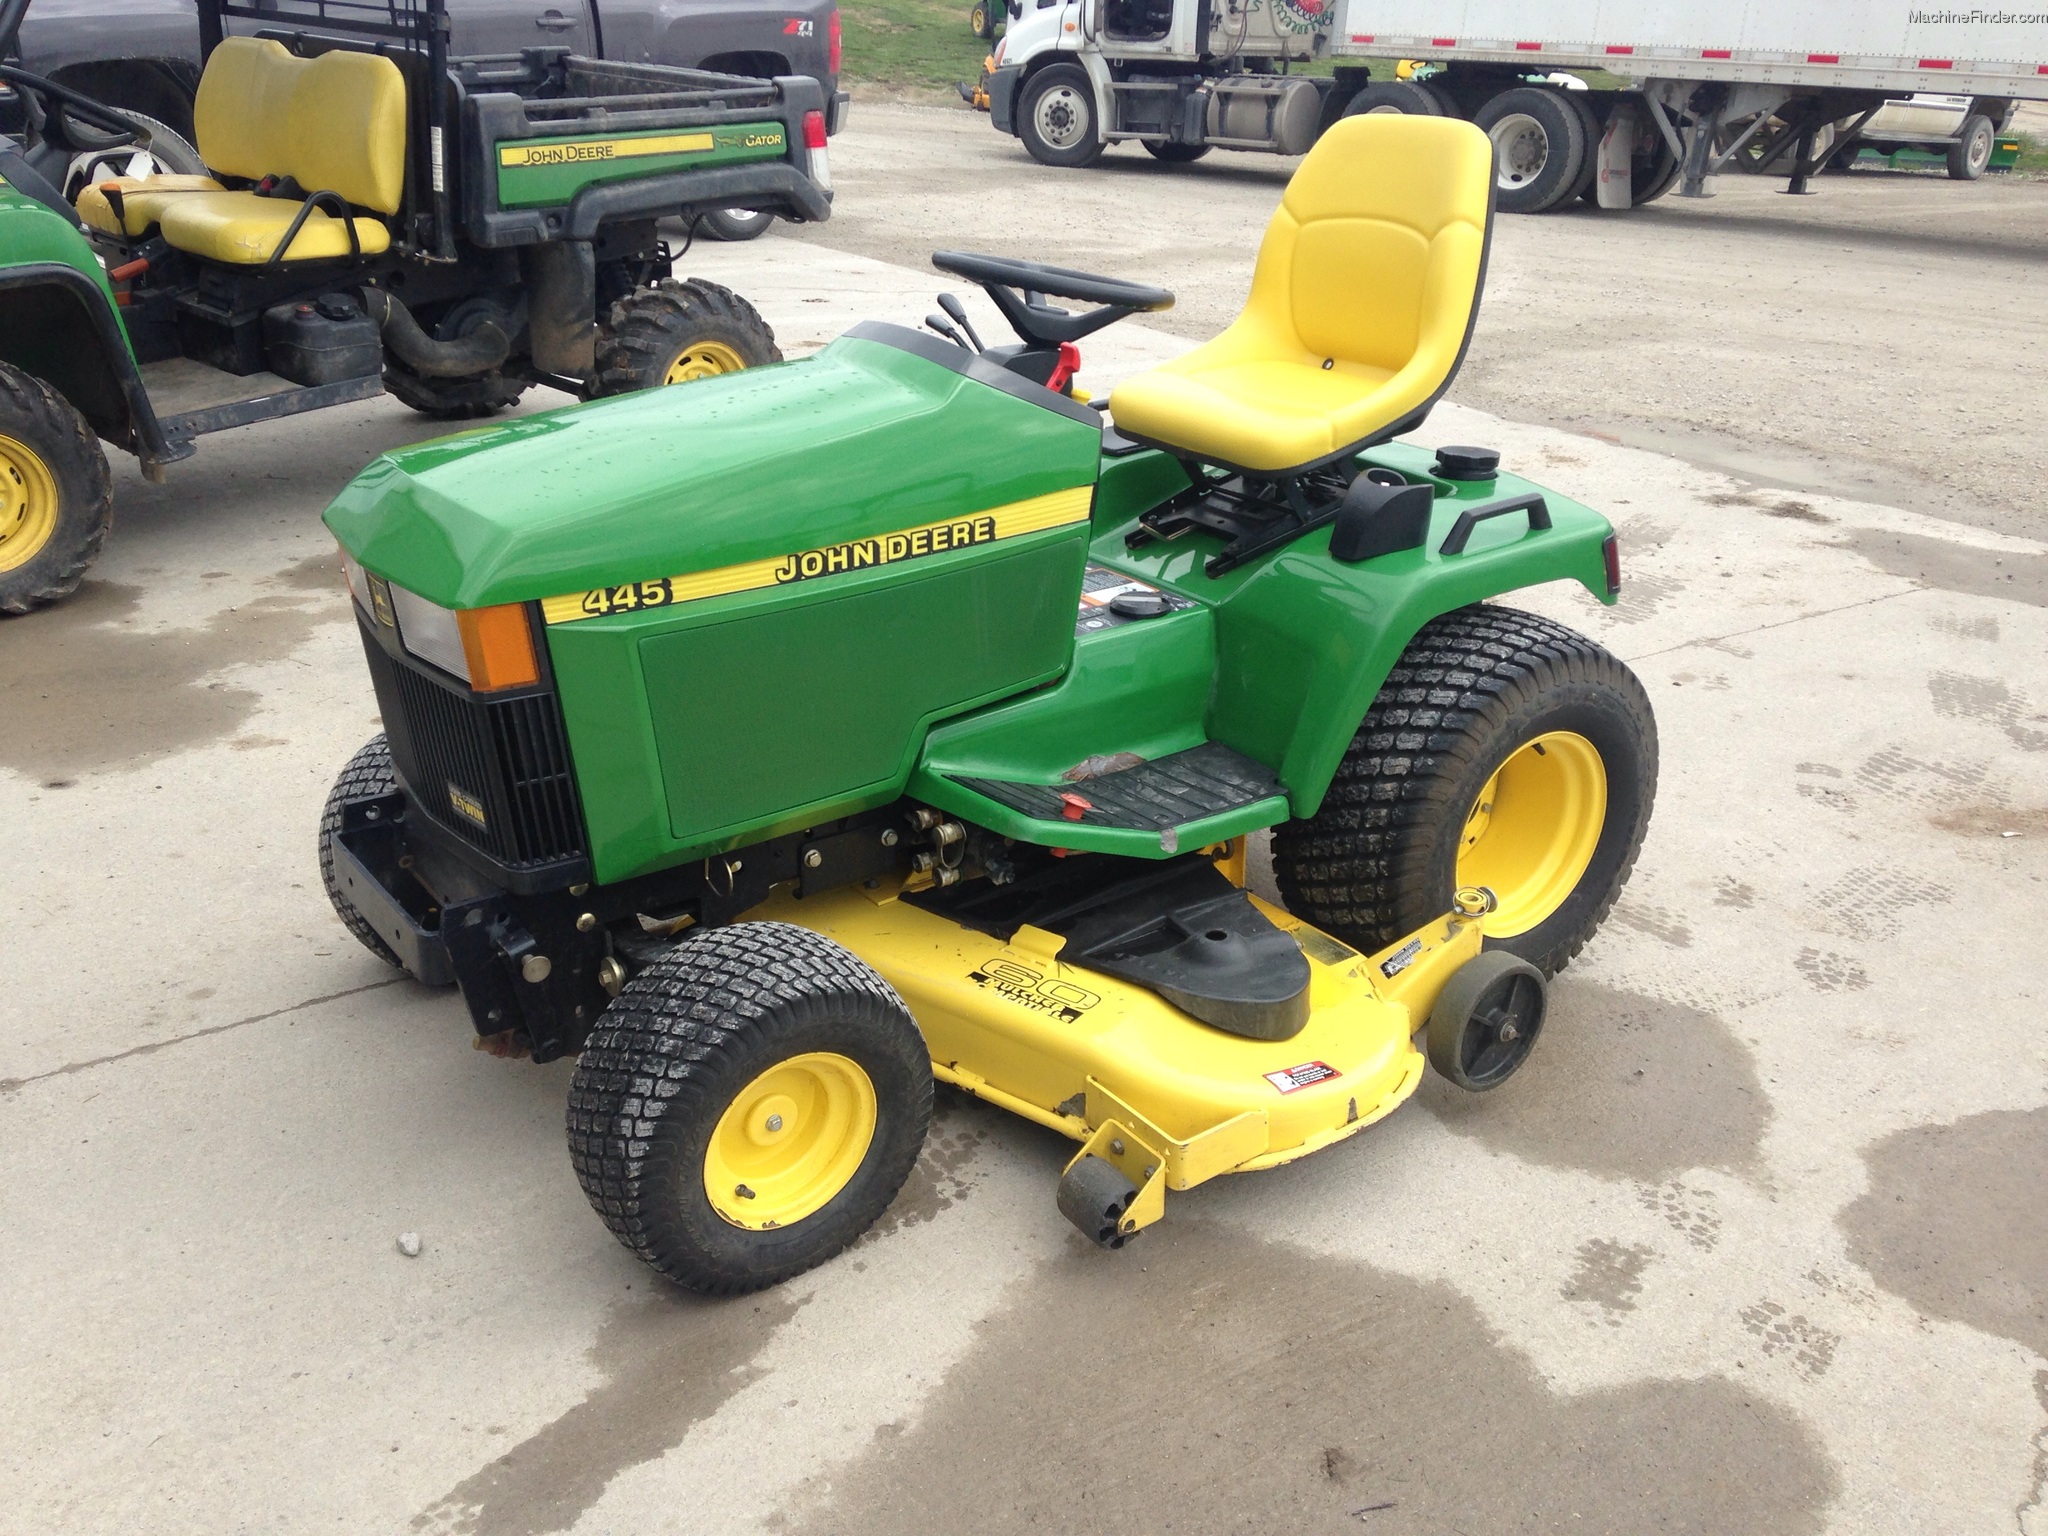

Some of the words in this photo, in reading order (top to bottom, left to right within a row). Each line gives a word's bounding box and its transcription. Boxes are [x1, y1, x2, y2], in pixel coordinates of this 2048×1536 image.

[783, 18, 813, 34] Z71
[746, 134, 782, 147] GATOR
[776, 539, 879, 584] JOHN
[886, 516, 996, 563] DEERE
[583, 578, 672, 615] 445
[450, 792, 485, 823] V-TWIN
[980, 958, 1102, 1010] 60
